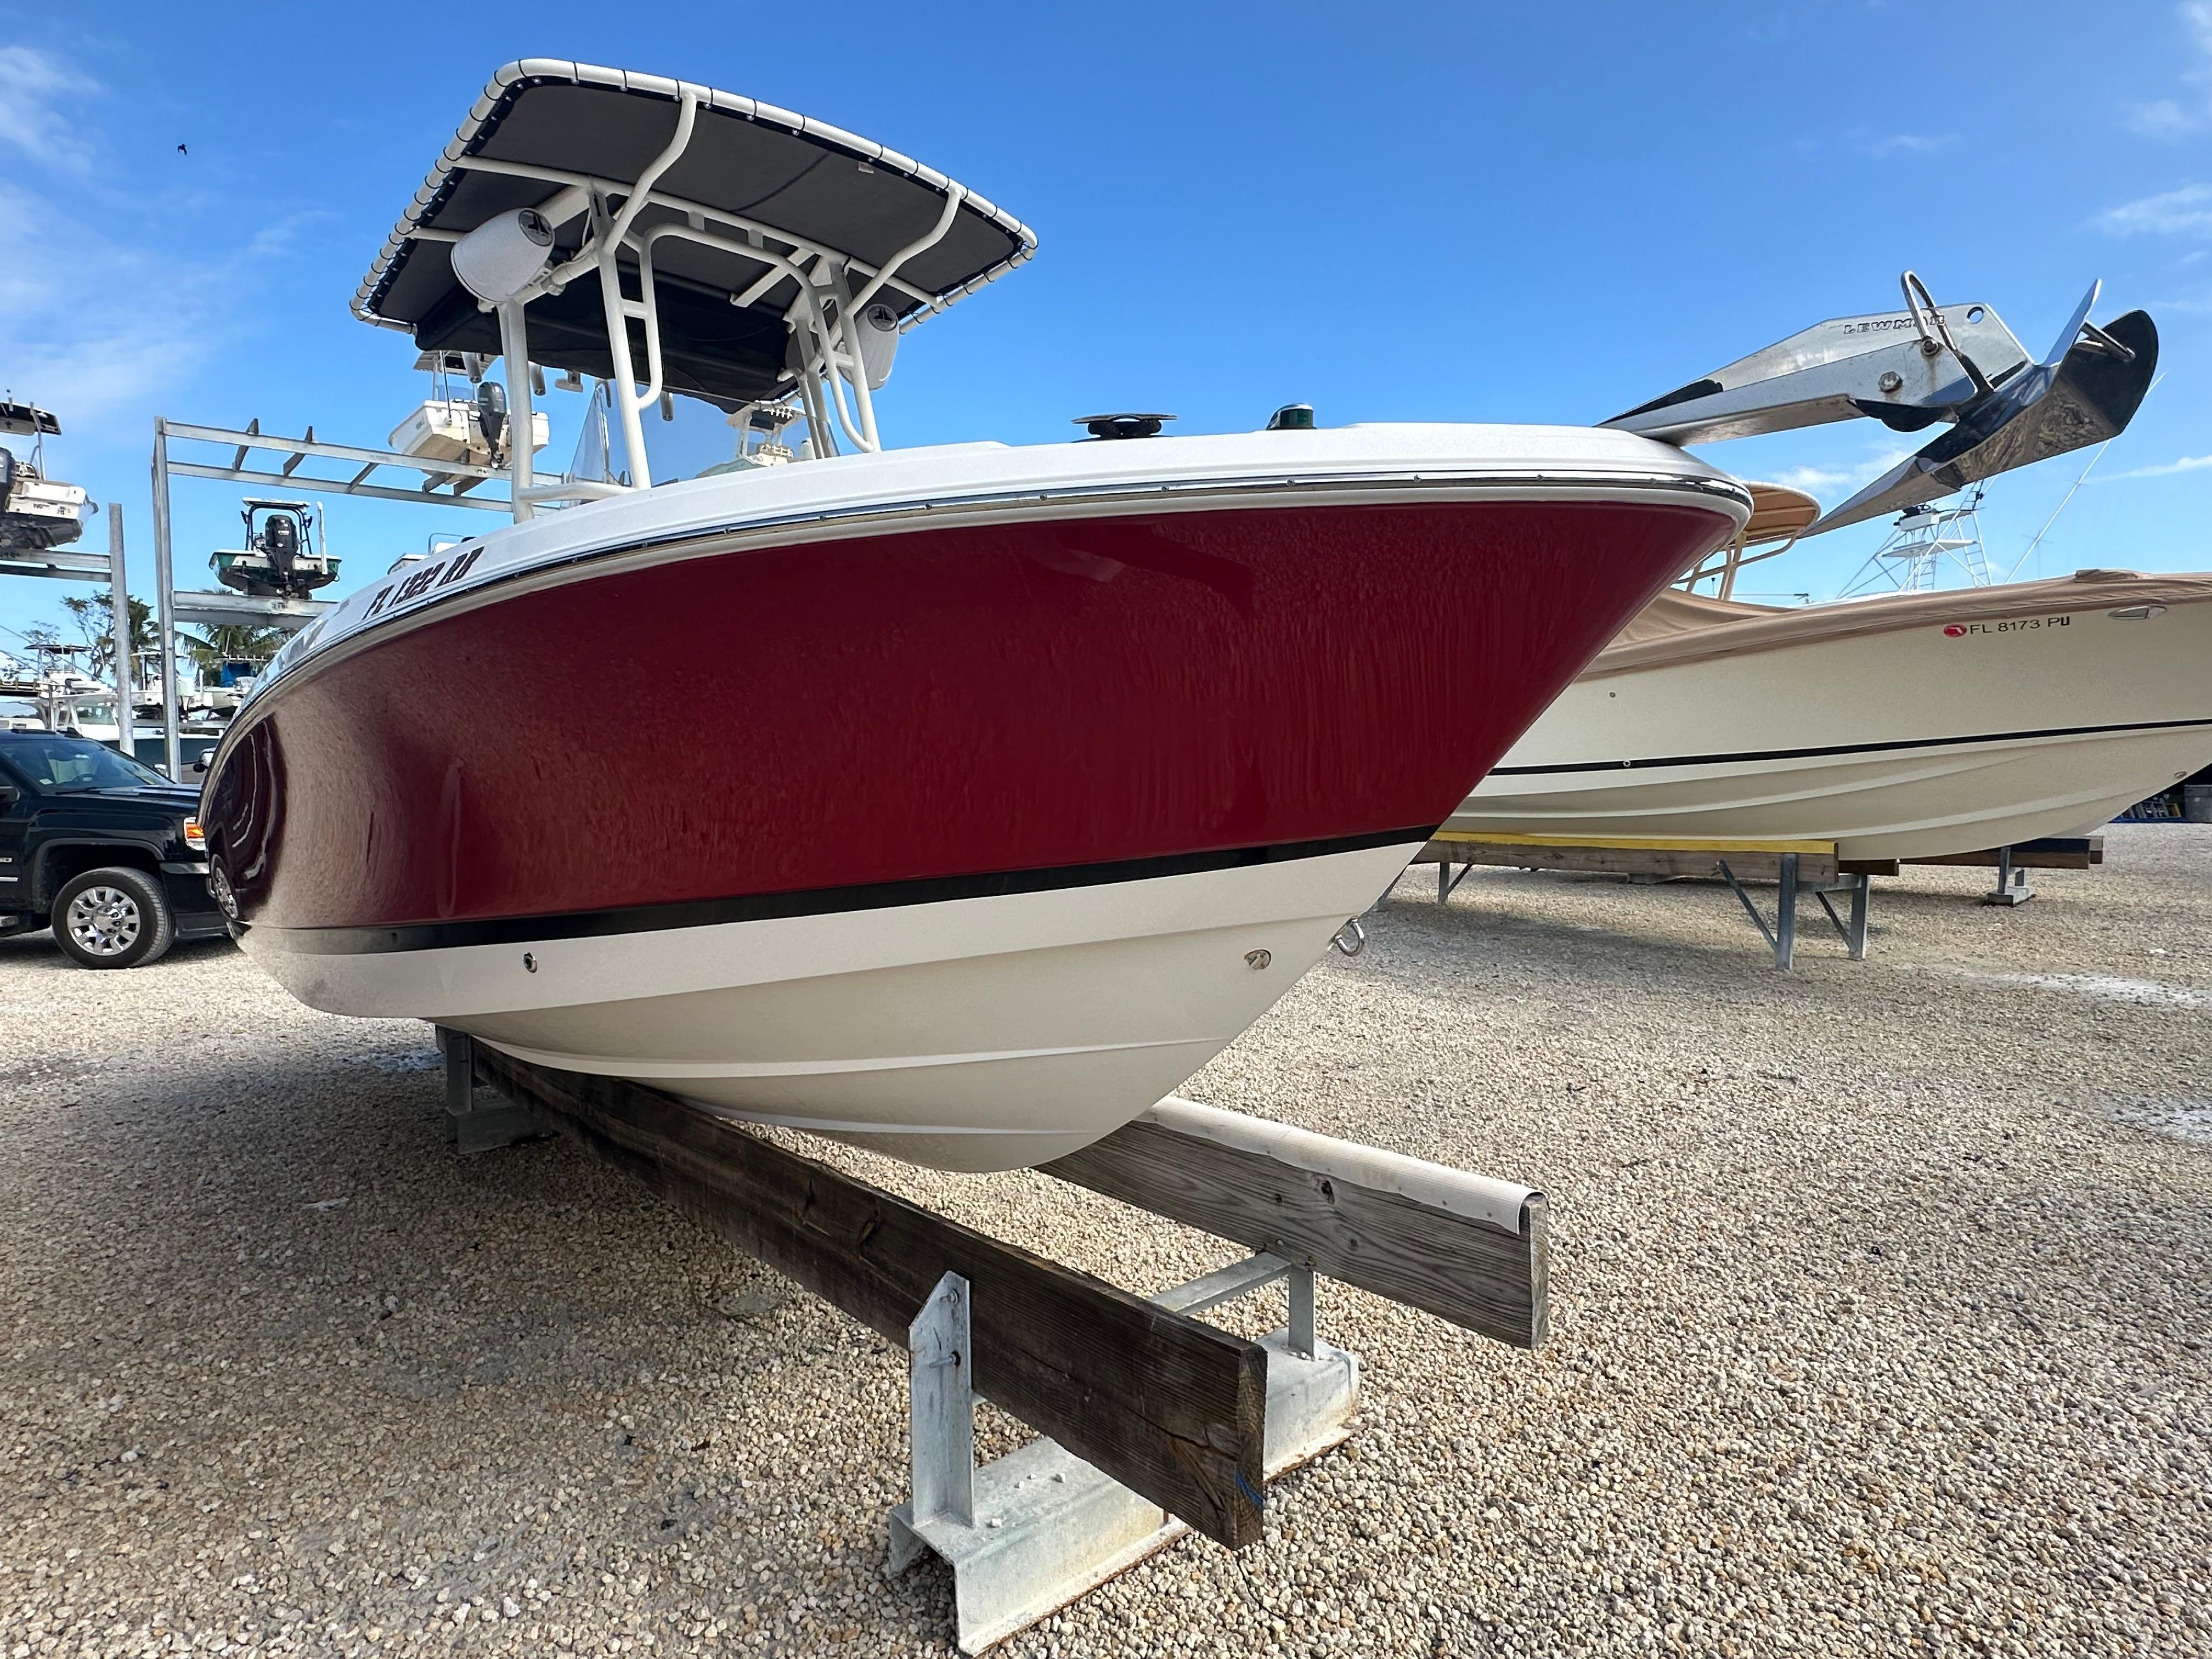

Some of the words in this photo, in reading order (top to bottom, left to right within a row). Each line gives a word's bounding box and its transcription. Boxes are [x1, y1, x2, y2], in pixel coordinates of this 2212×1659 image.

[362, 584, 394, 620] FL
[1970, 624, 1993, 635] FL
[1998, 619, 2041, 632] 8173
